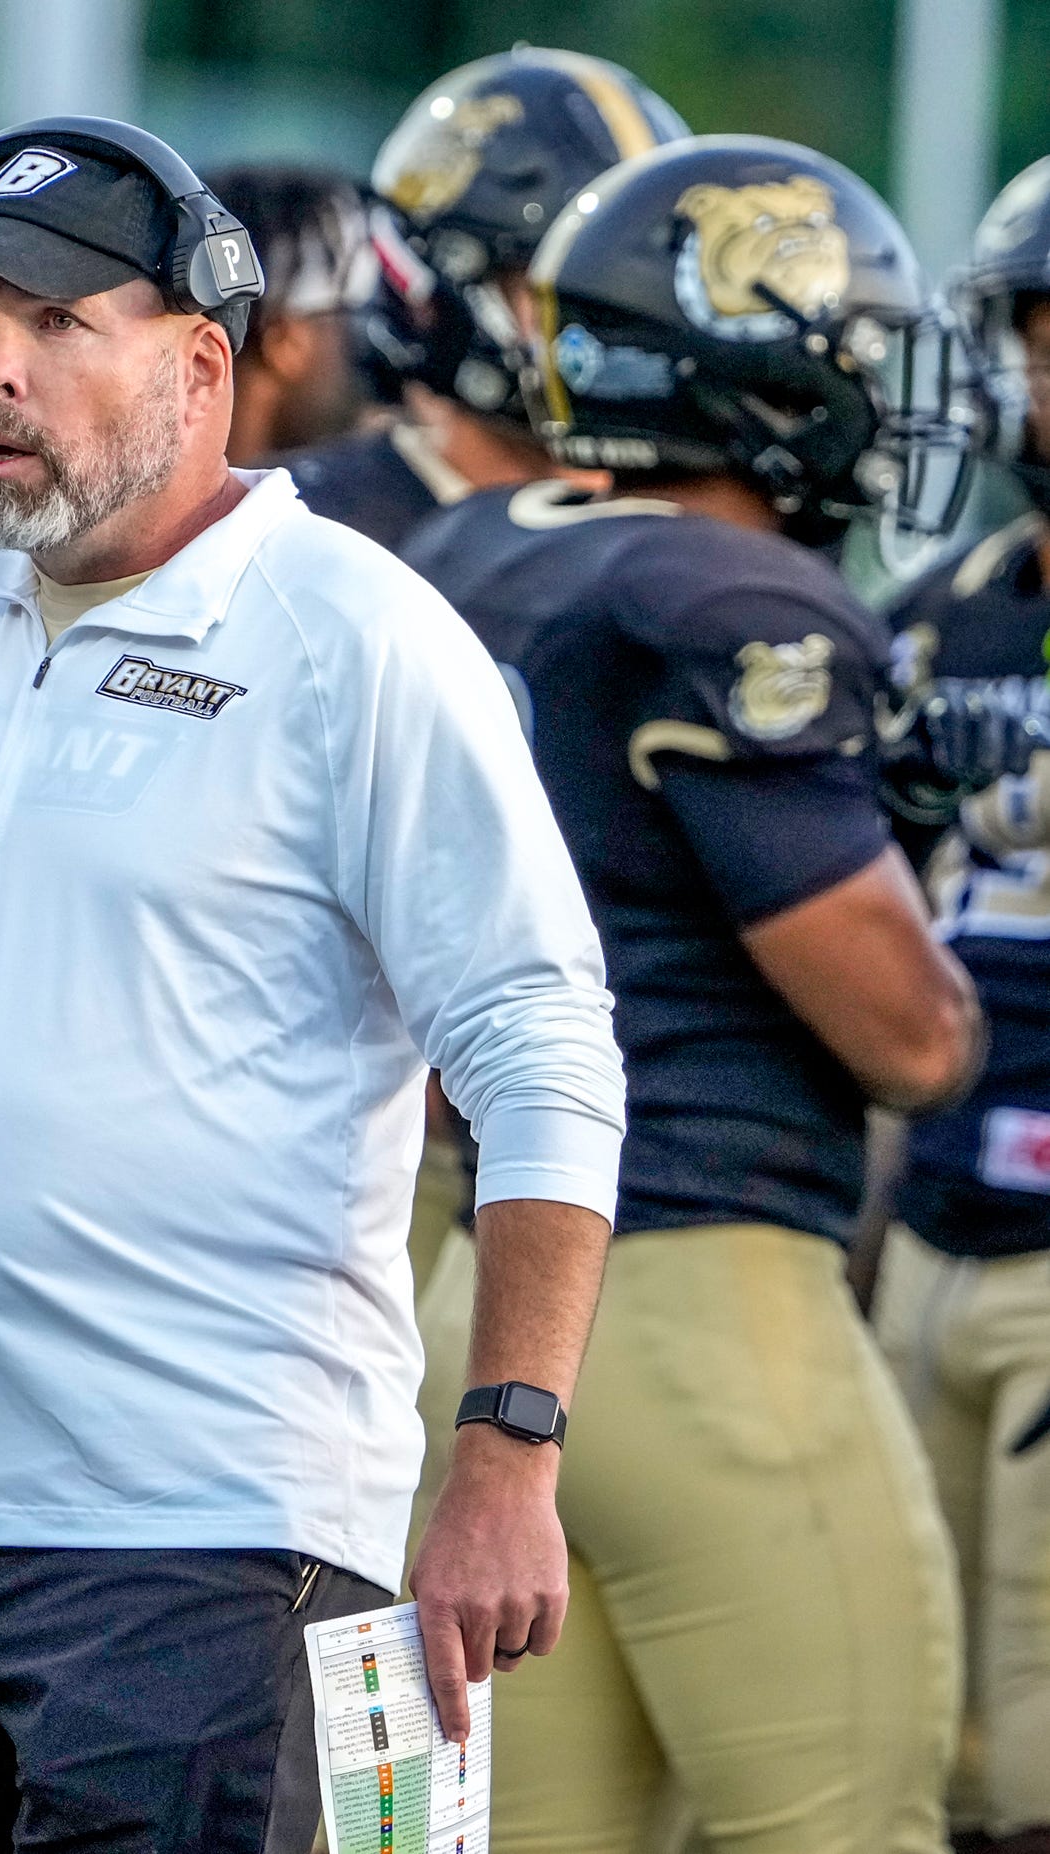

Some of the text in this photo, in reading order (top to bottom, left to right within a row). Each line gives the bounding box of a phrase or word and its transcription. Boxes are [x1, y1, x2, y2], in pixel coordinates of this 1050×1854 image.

[221, 238, 241, 282] P
[103, 660, 234, 705] BRYANT
[129, 687, 215, 716] FOOTBALL
